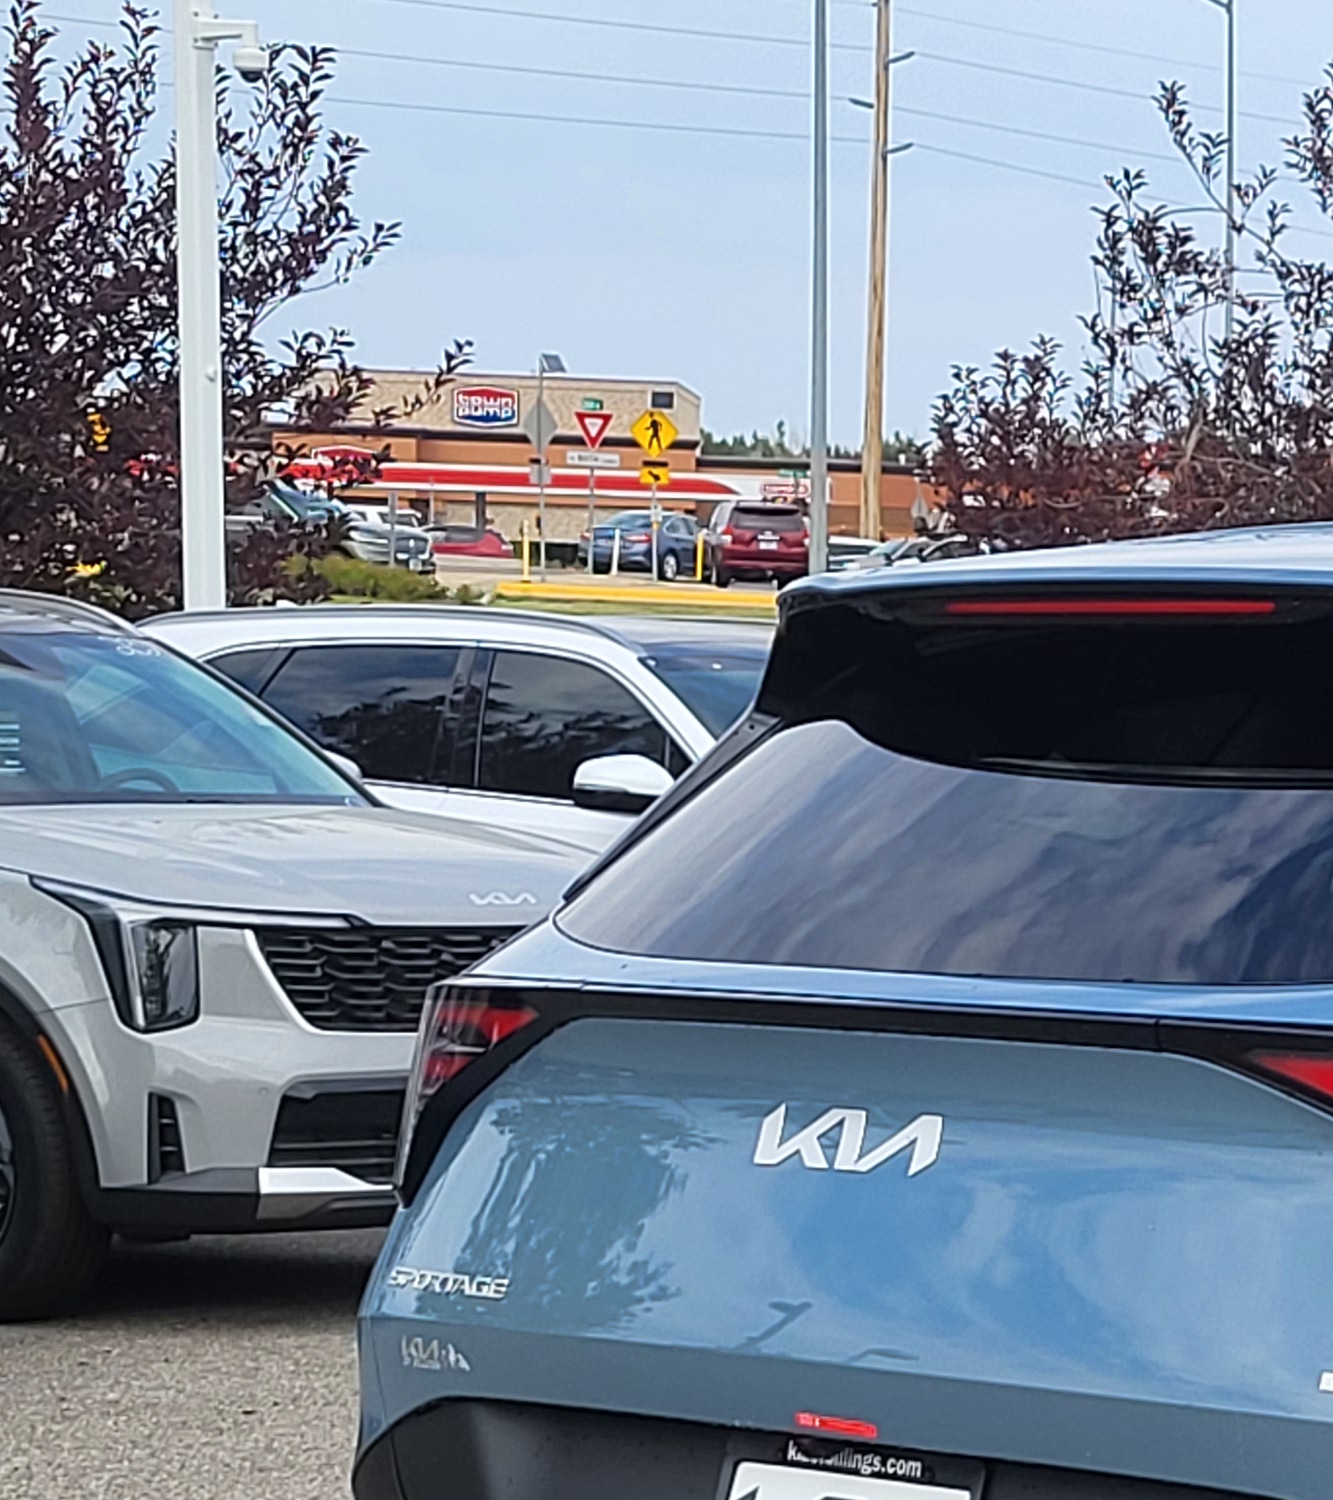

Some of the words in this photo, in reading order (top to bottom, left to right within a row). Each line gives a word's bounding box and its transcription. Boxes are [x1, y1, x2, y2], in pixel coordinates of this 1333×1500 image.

[469, 892, 536, 905] KIA
[753, 1102, 943, 1177] KIA
[388, 1265, 510, 1299] SPORTAGE
